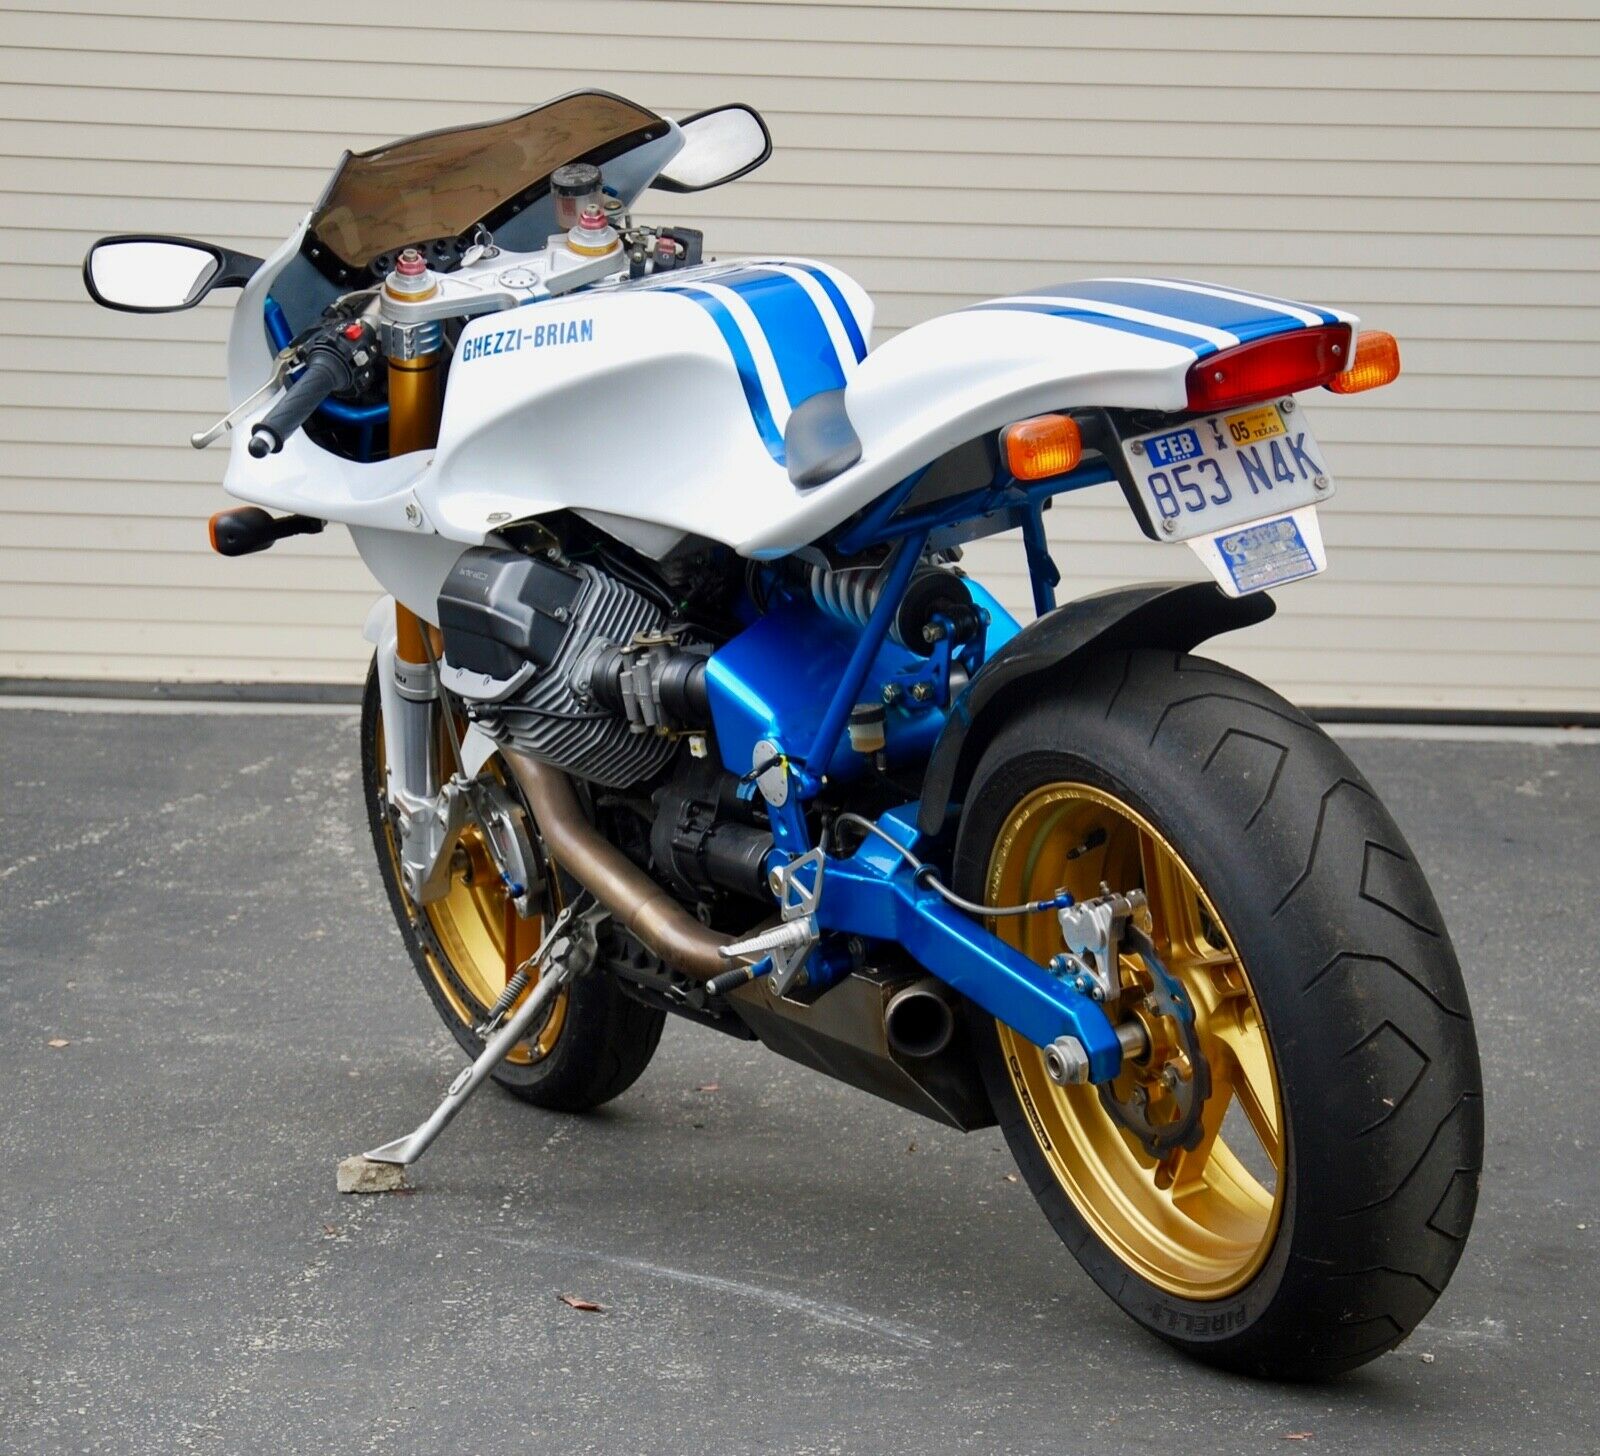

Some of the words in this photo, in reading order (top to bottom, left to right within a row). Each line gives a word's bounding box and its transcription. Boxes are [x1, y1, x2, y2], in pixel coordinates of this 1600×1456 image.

[462, 319, 593, 362] GHEZZI-BRIAN
[1229, 419, 1250, 442] 05
[1252, 425, 1279, 438] TEXAS
[1155, 434, 1196, 461] FEB
[1236, 432, 1322, 495] N4K
